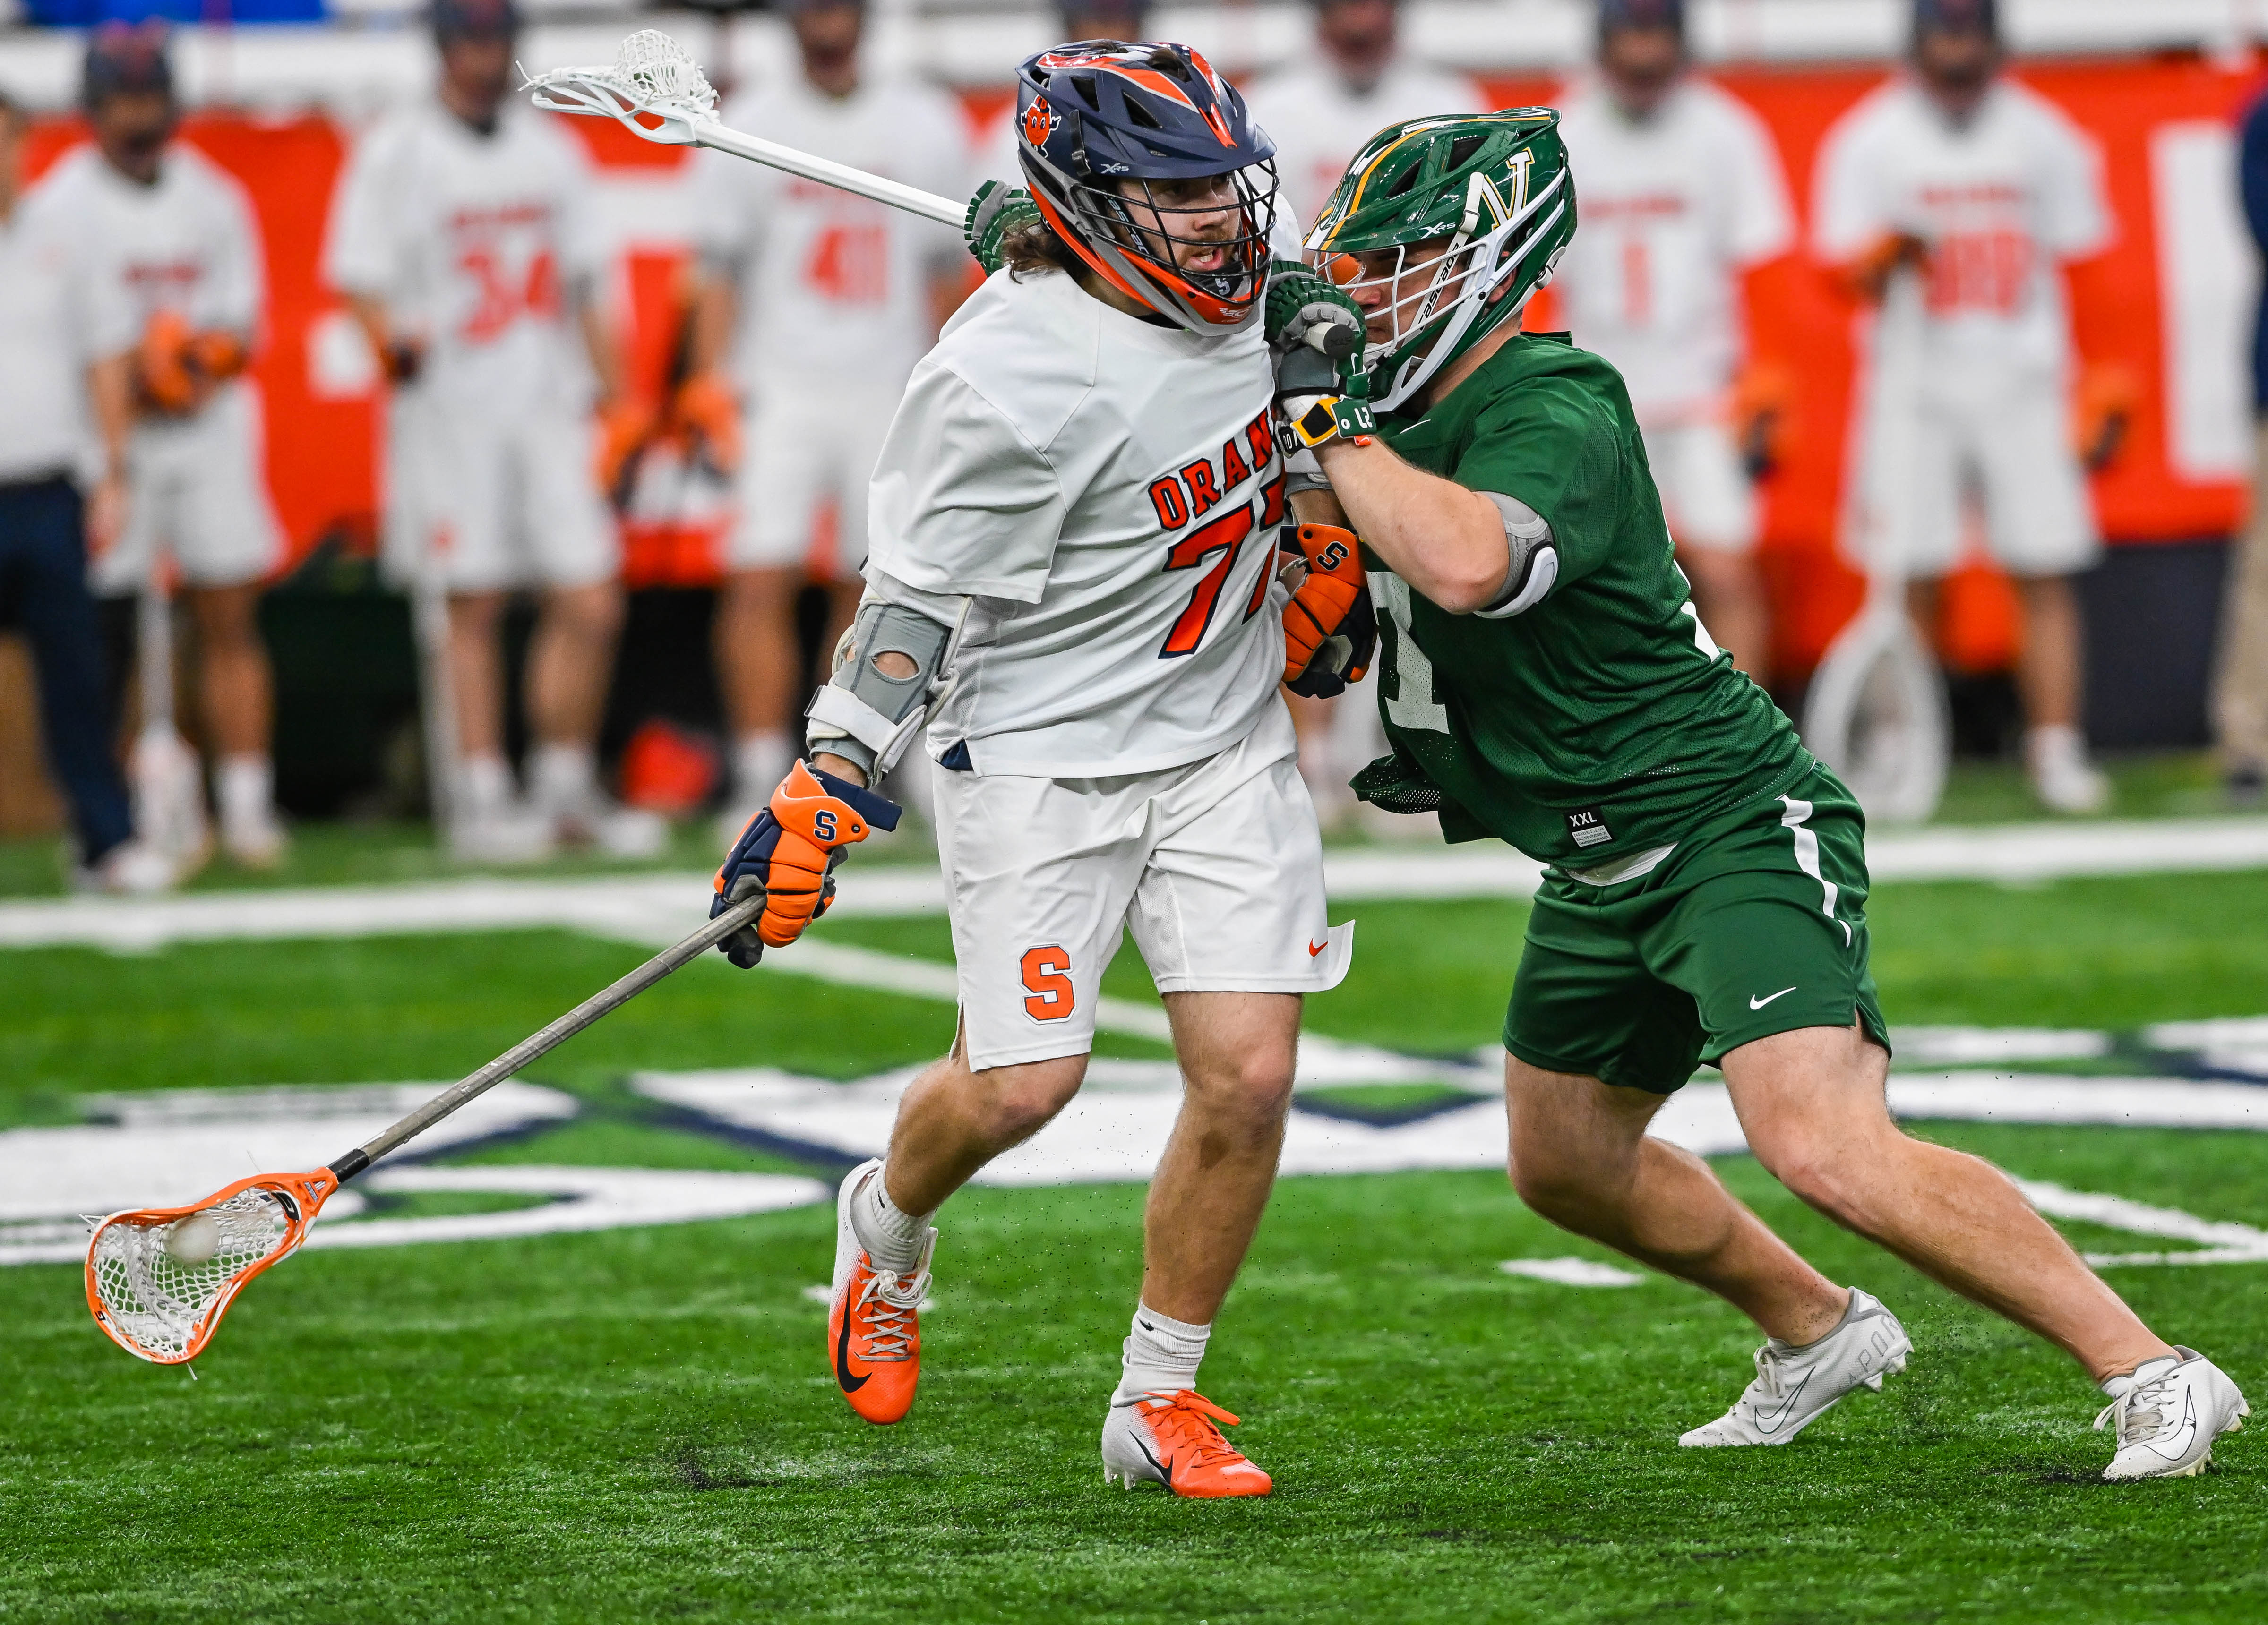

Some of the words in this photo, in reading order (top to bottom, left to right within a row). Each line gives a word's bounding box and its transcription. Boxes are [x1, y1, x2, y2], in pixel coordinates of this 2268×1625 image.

[1100, 163, 1129, 174] XRS
[1419, 222, 1456, 239] XRS
[1148, 406, 1274, 531] ORAN
[1316, 541, 1349, 571] S
[813, 809, 838, 842] S
[1569, 812, 1597, 827] XXL
[1018, 943, 1076, 1025] S
